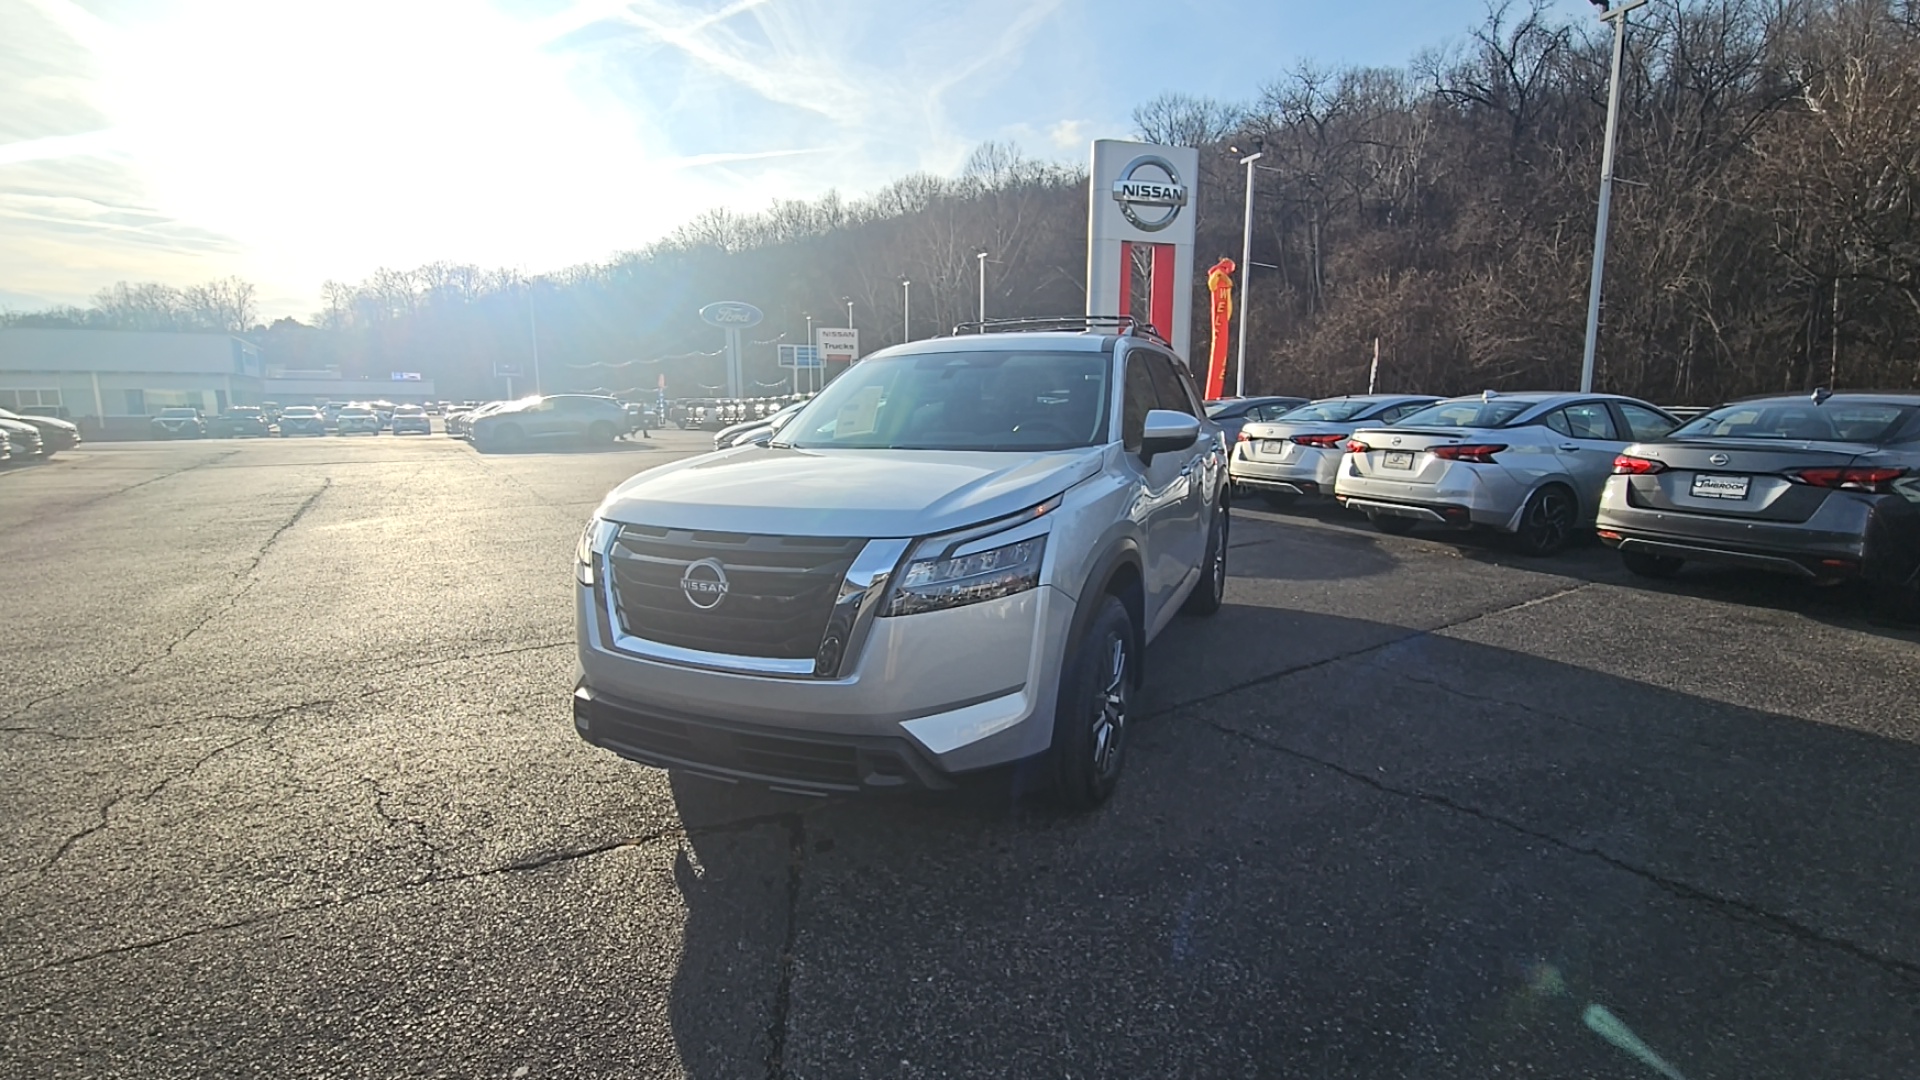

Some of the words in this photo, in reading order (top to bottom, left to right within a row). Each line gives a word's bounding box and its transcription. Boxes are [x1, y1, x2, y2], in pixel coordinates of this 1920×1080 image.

[1122, 184, 1182, 200] NISSAN
[715, 307, 751, 322] Ford
[1214, 287, 1227, 380] WELCE
[823, 342, 854, 350] Trucks
[680, 578, 729, 593] NISSAN
